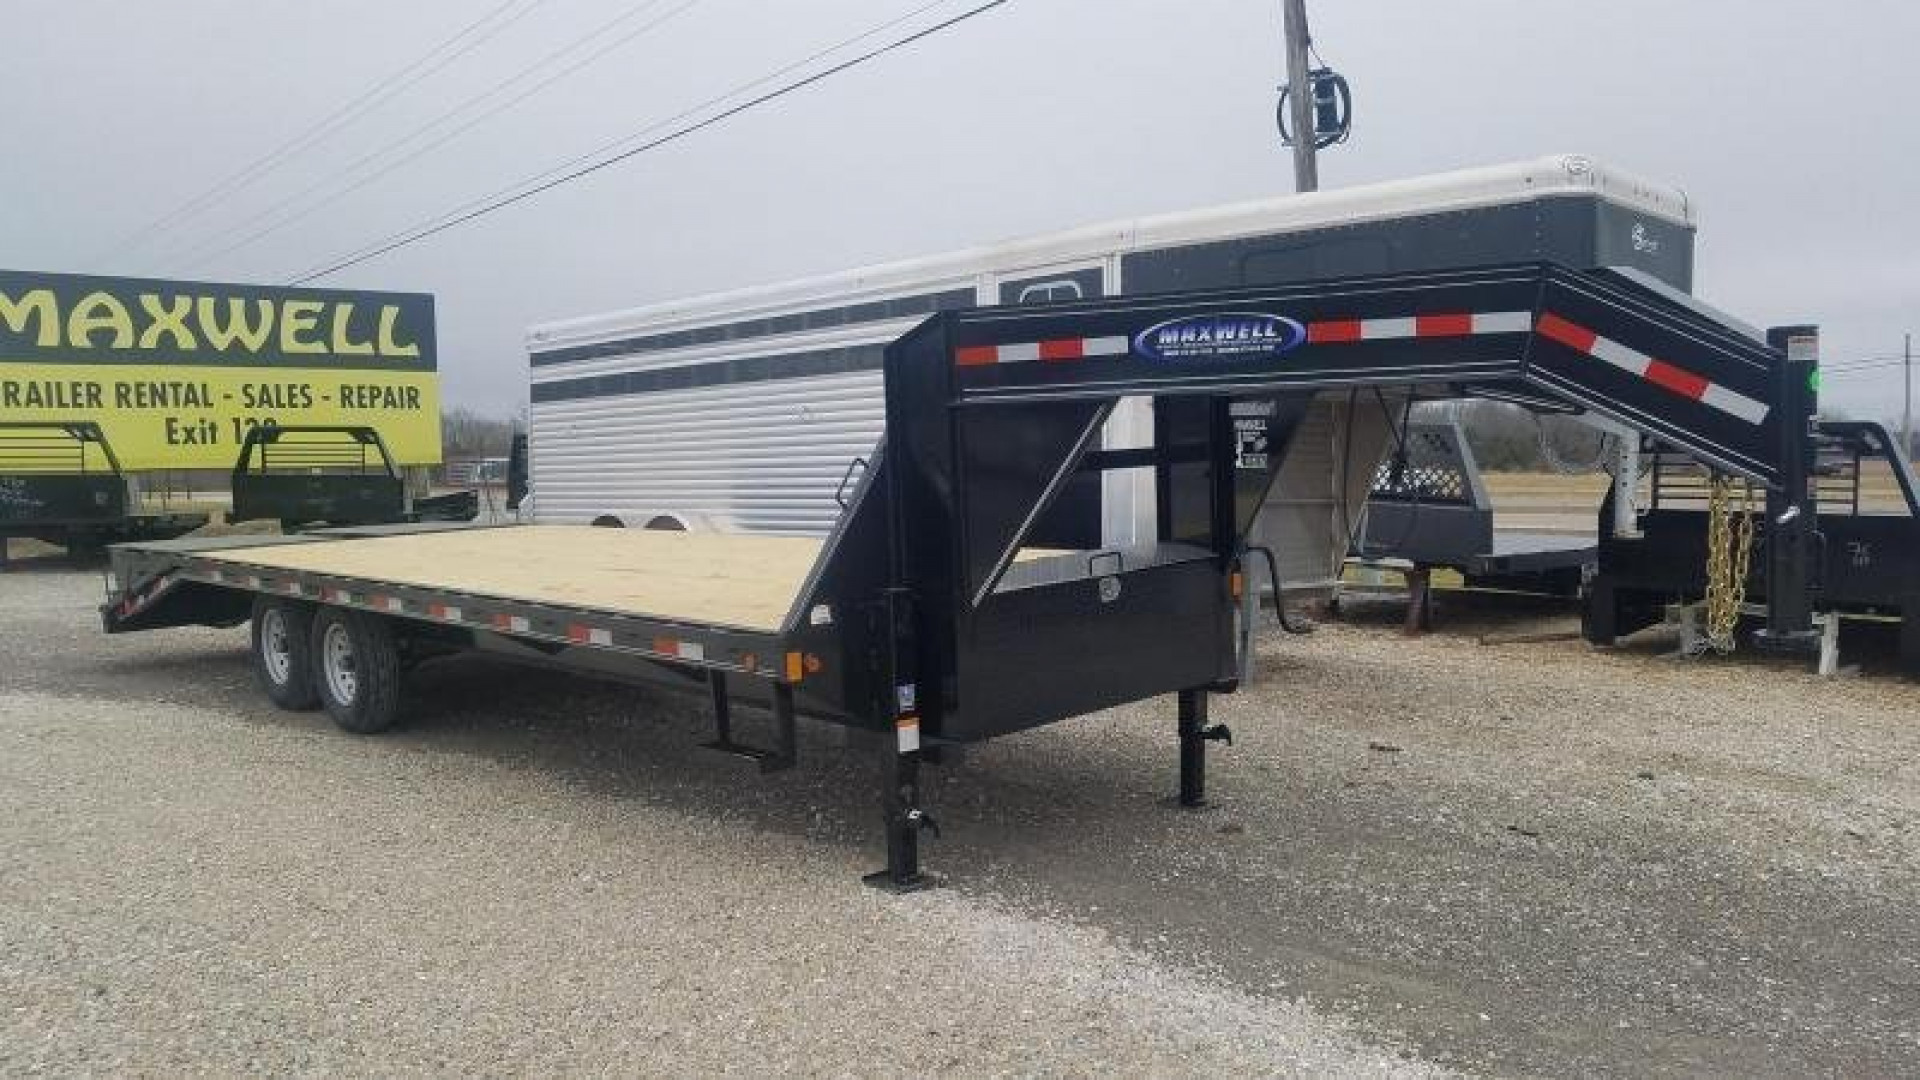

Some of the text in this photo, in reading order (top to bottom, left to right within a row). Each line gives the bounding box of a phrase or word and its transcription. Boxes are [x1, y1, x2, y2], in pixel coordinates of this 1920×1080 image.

[0, 289, 420, 356] MAXWELL
[1158, 321, 1278, 344] MAXWELL
[2, 380, 103, 408] RAILER
[114, 381, 214, 409] RENTAL
[244, 383, 313, 409] SALES
[340, 385, 421, 410] REPAIR
[165, 417, 218, 445] Exit
